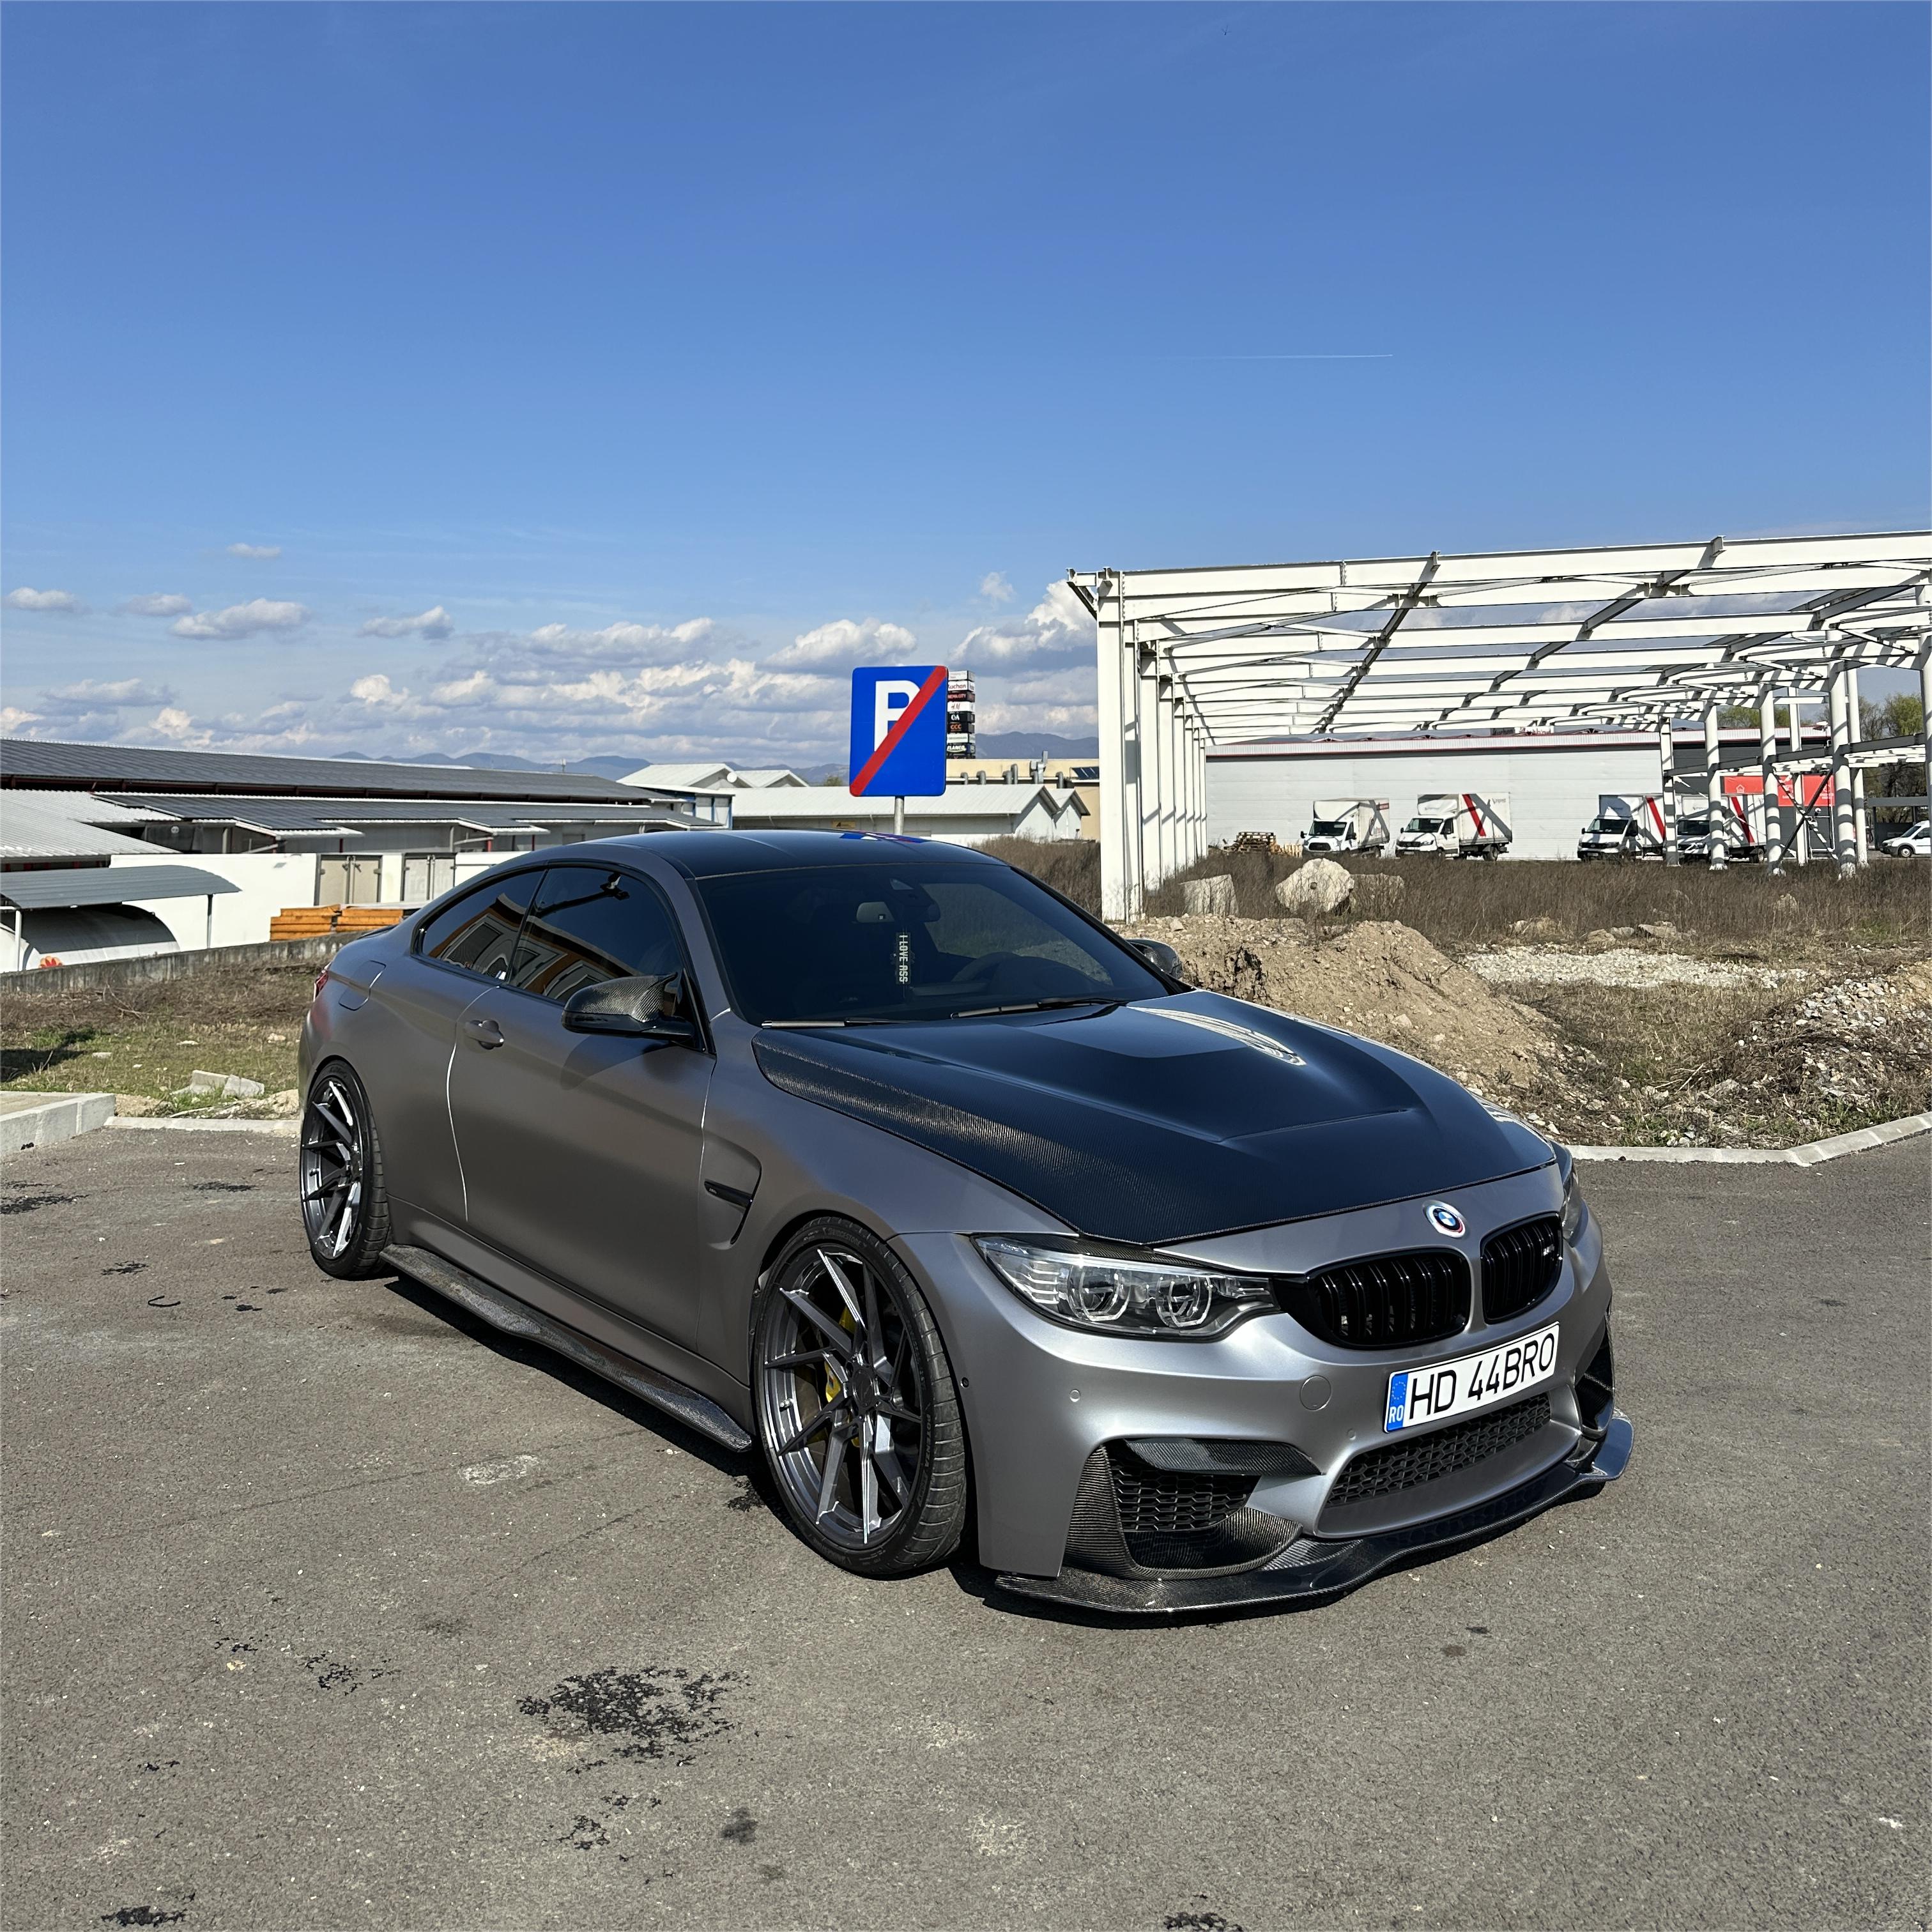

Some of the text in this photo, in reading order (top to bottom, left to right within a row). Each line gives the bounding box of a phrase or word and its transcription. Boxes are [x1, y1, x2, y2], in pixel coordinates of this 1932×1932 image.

[874, 680, 920, 751] P
[899, 941, 908, 962] LOVE
[899, 965, 908, 983] ASS
[1409, 1333, 1555, 1420] HD 44BRO
[1388, 1405, 1404, 1424] RO
